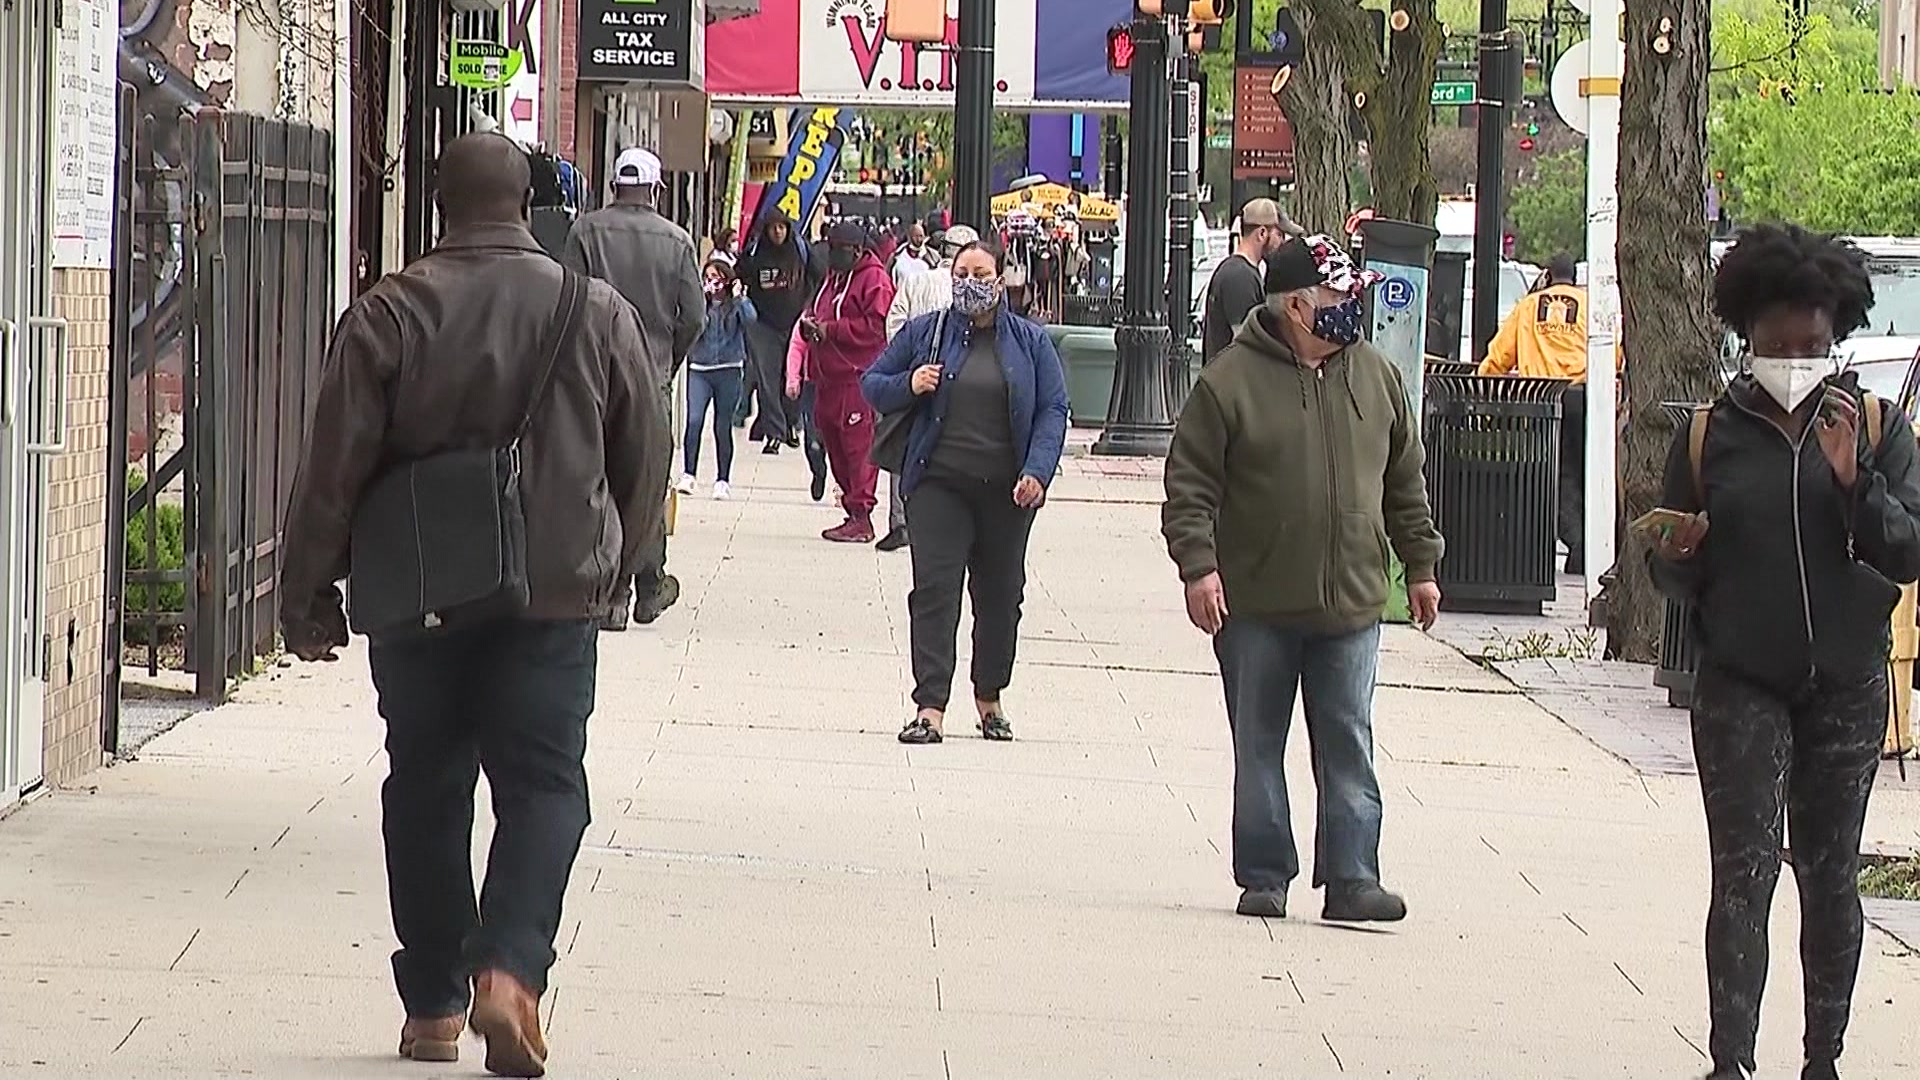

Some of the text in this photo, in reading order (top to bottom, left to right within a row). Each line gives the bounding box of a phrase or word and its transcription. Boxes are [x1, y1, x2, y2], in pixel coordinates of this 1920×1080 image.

[601, 11, 668, 27] ALL CITY
[615, 31, 654, 48] TAX
[592, 48, 676, 66] SERVICE
[1189, 90, 1197, 136] STOP
[751, 117, 769, 133] 51
